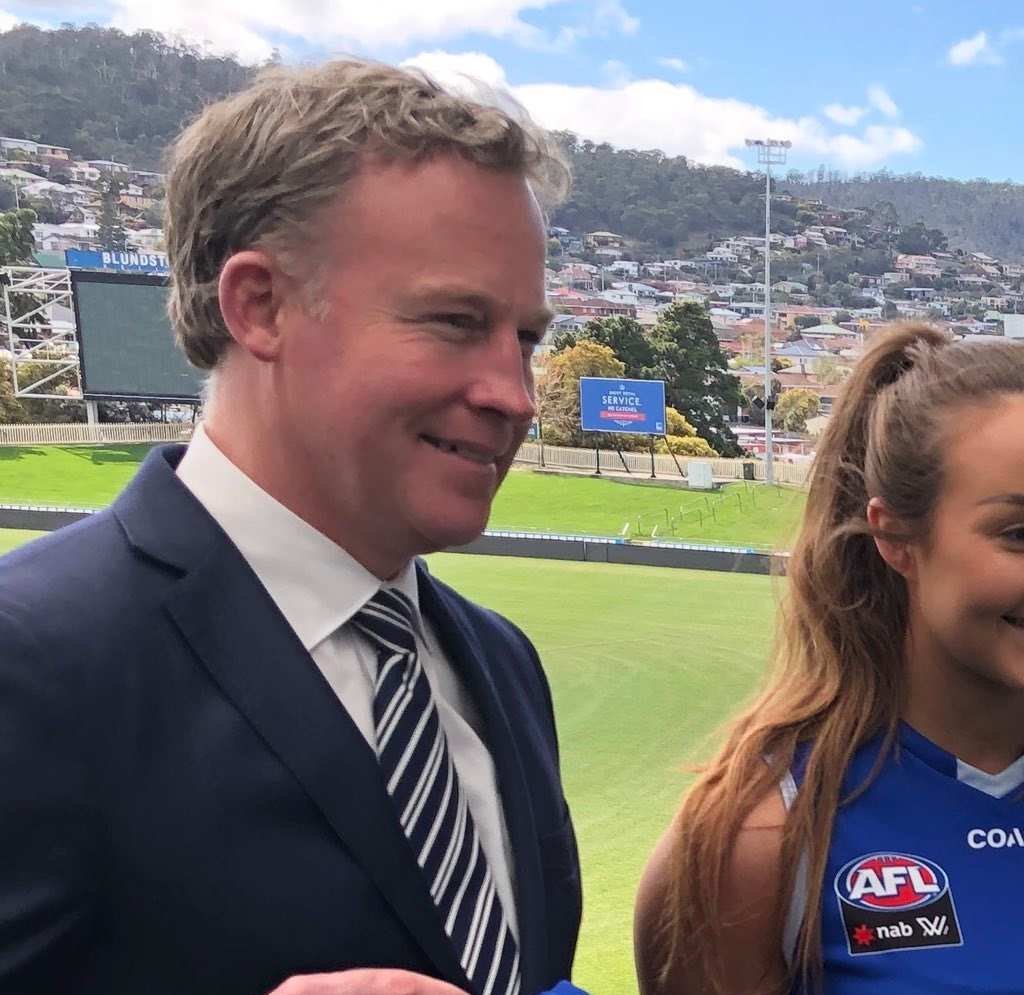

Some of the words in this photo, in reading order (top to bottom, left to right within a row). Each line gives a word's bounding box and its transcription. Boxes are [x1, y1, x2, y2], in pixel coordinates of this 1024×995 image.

[602, 395, 641, 406] SERVICE
[850, 865, 938, 900] AFL
[876, 921, 913, 939] nab
